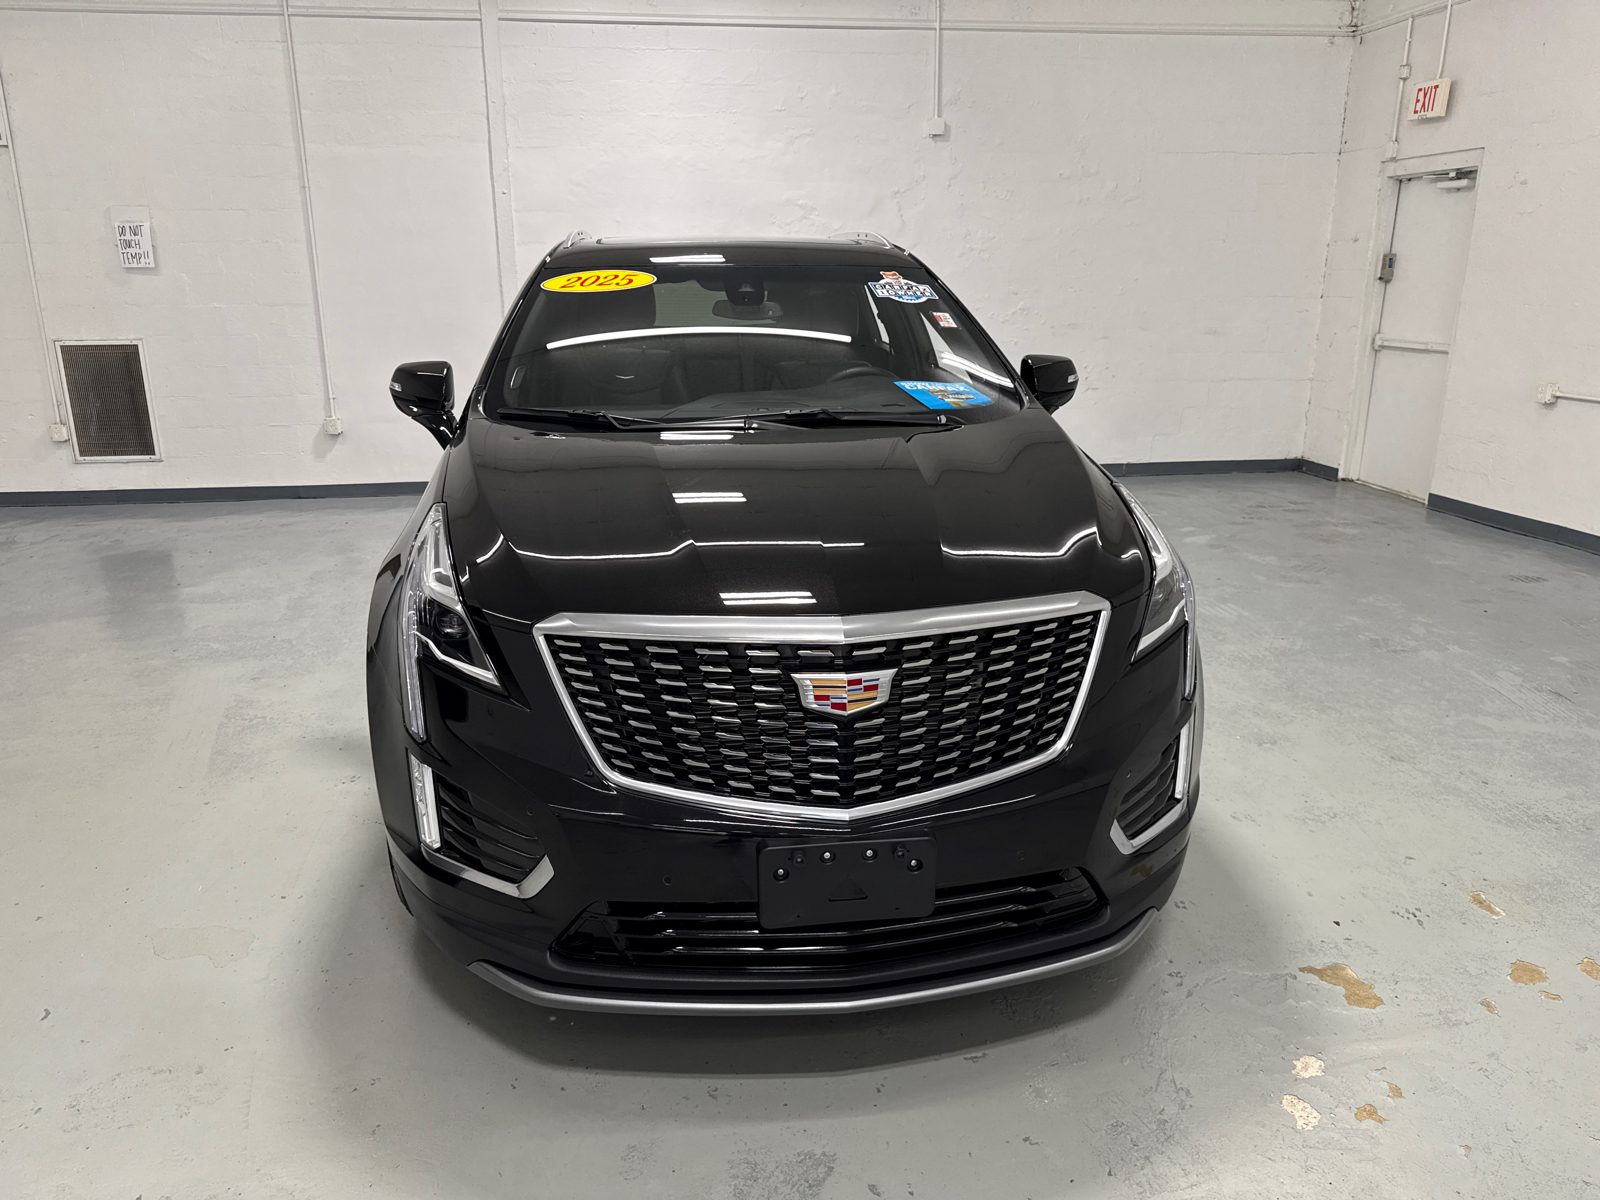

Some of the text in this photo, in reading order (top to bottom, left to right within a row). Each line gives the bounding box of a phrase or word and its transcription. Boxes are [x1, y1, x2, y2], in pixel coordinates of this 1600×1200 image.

[1413, 84, 1440, 115] EXIT
[117, 224, 145, 238] DO NOT
[118, 238, 142, 251] TOUCH
[121, 250, 151, 265] TEMP!!
[559, 274, 639, 289] 2025
